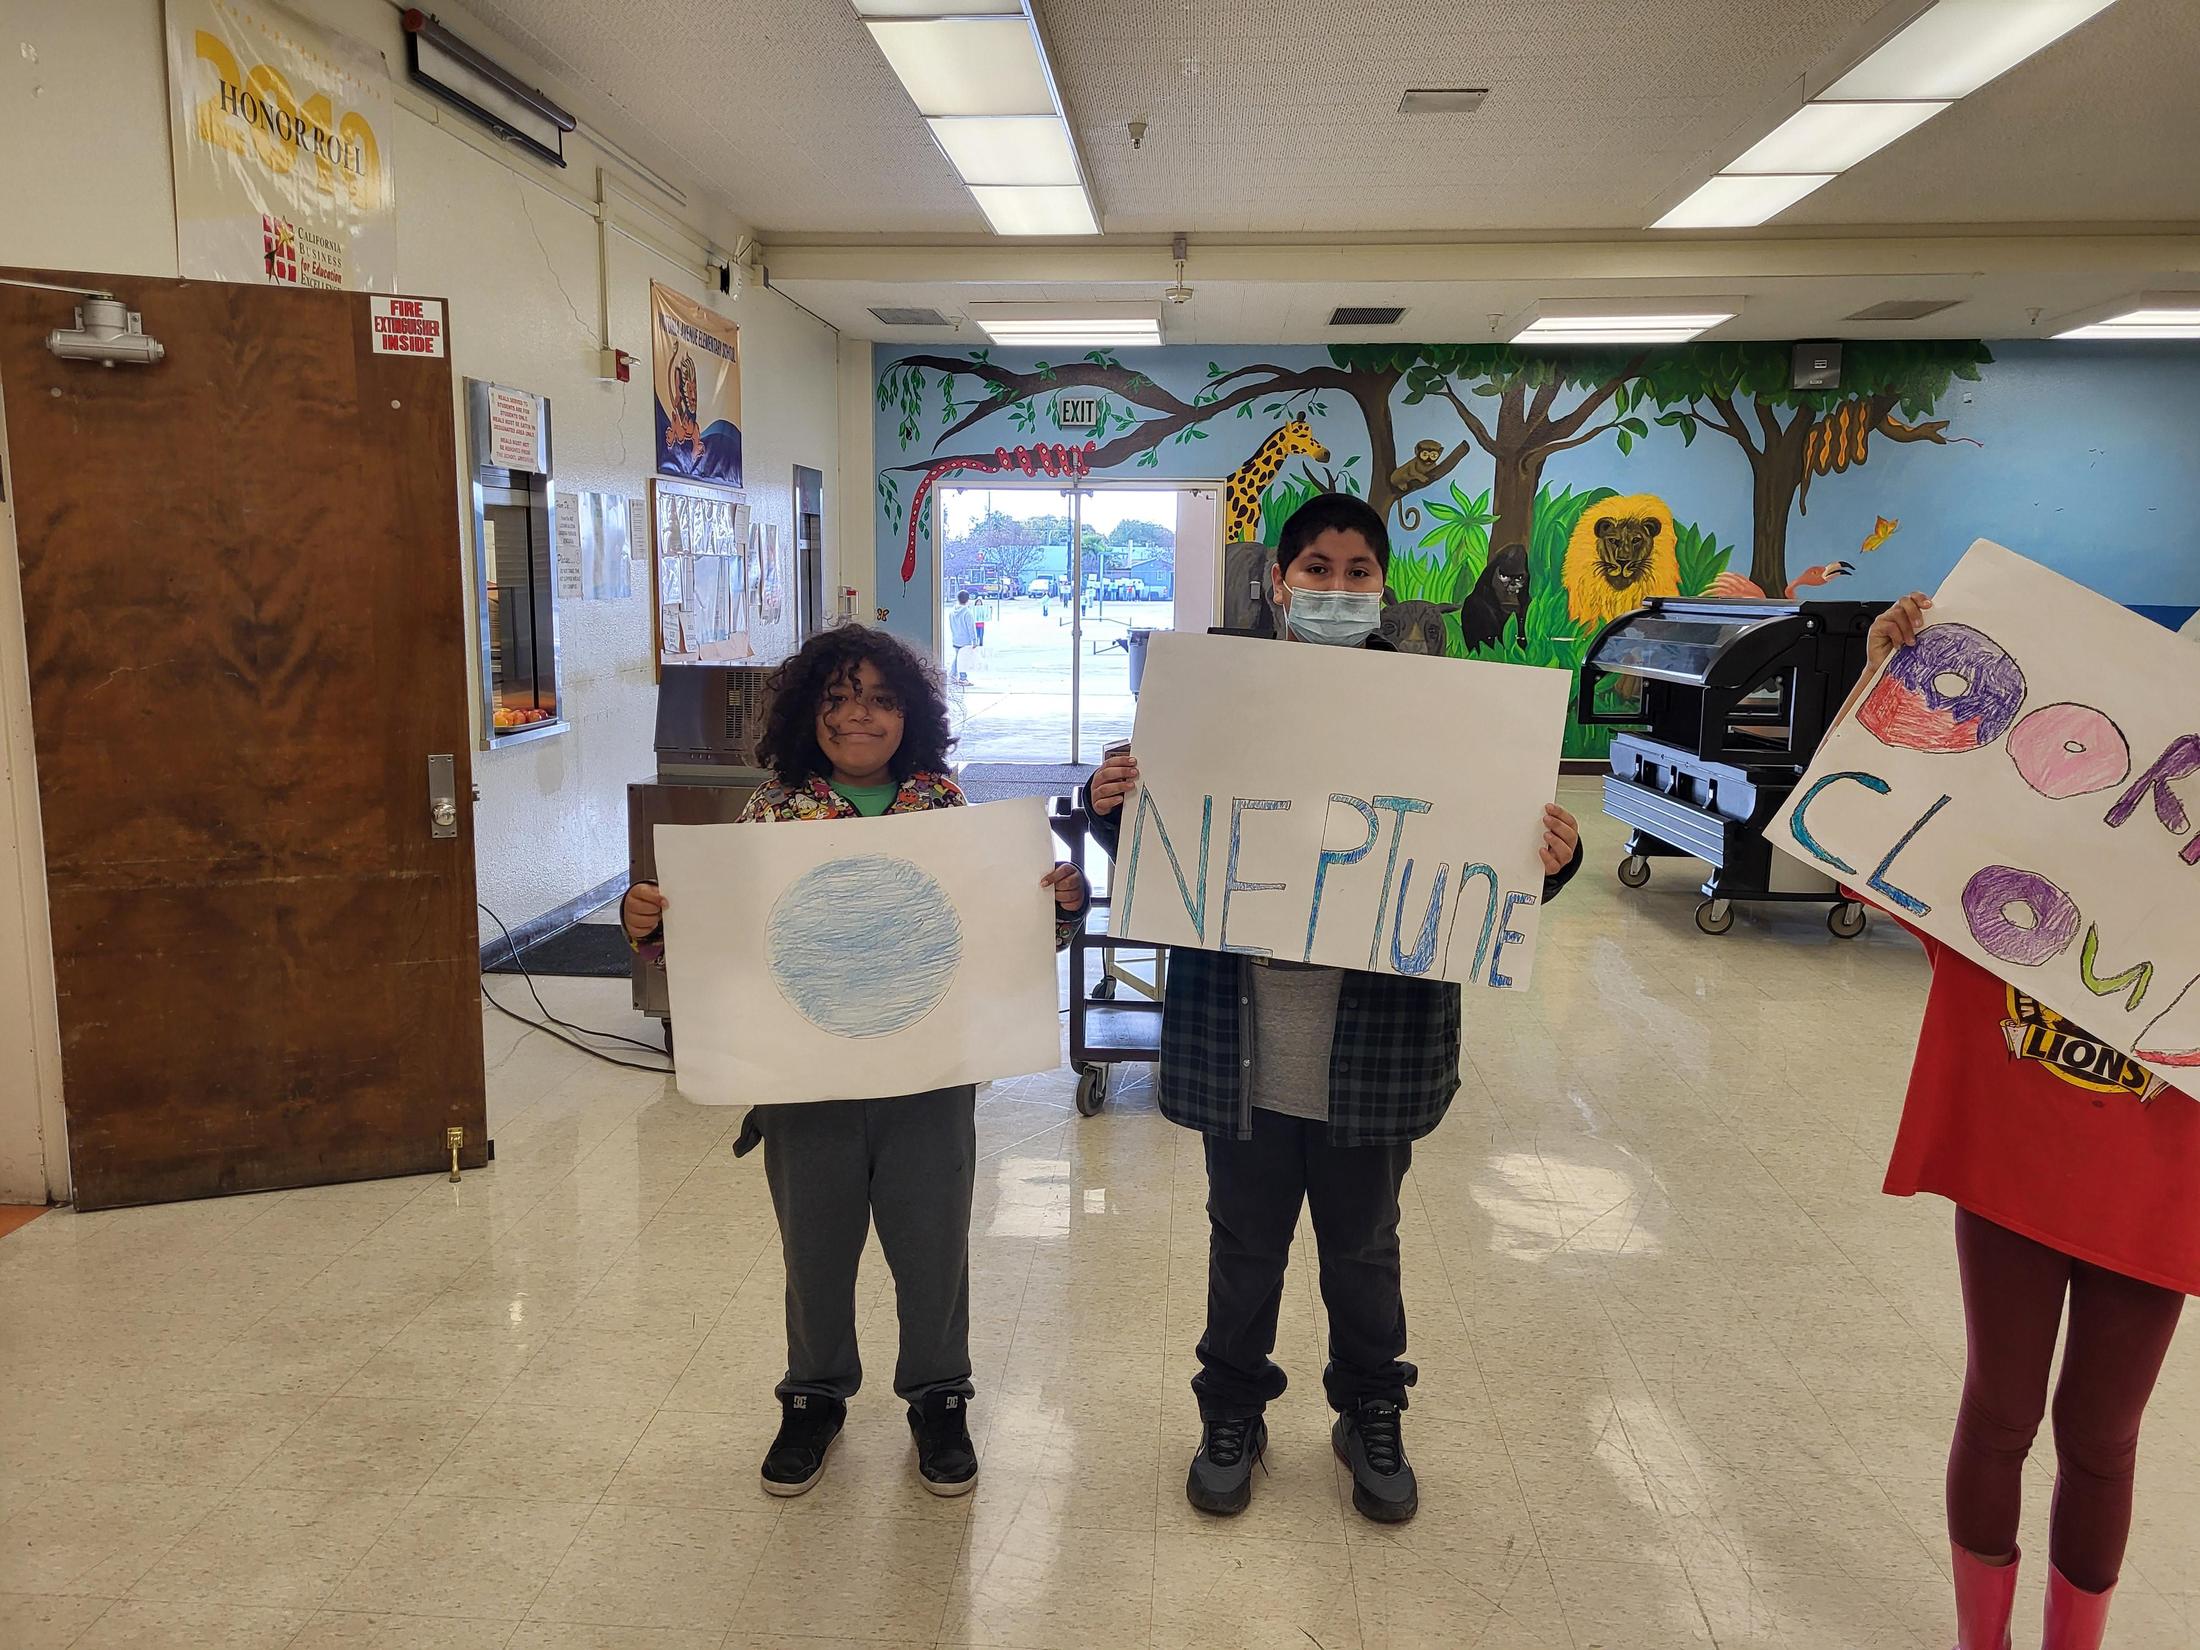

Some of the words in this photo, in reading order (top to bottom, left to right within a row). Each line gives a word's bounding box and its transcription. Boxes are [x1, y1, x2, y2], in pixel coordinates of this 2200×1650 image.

[218, 78, 310, 152] HONOR
[313, 125, 366, 177] ROLL
[297, 227, 342, 254] CALIFORNIA
[299, 242, 342, 268] BUSINESS
[300, 256, 311, 274] for
[311, 261, 342, 284] Education
[390, 299, 424, 319] FIRE
[374, 315, 440, 337] EXTINGUISHER
[382, 333, 434, 354] INSIDE
[698, 330, 722, 357] ELEMENTARY
[722, 341, 737, 364] SCHOOL
[1063, 400, 1095, 423] EXIT
[2025, 1025, 2146, 1089] LIONS
